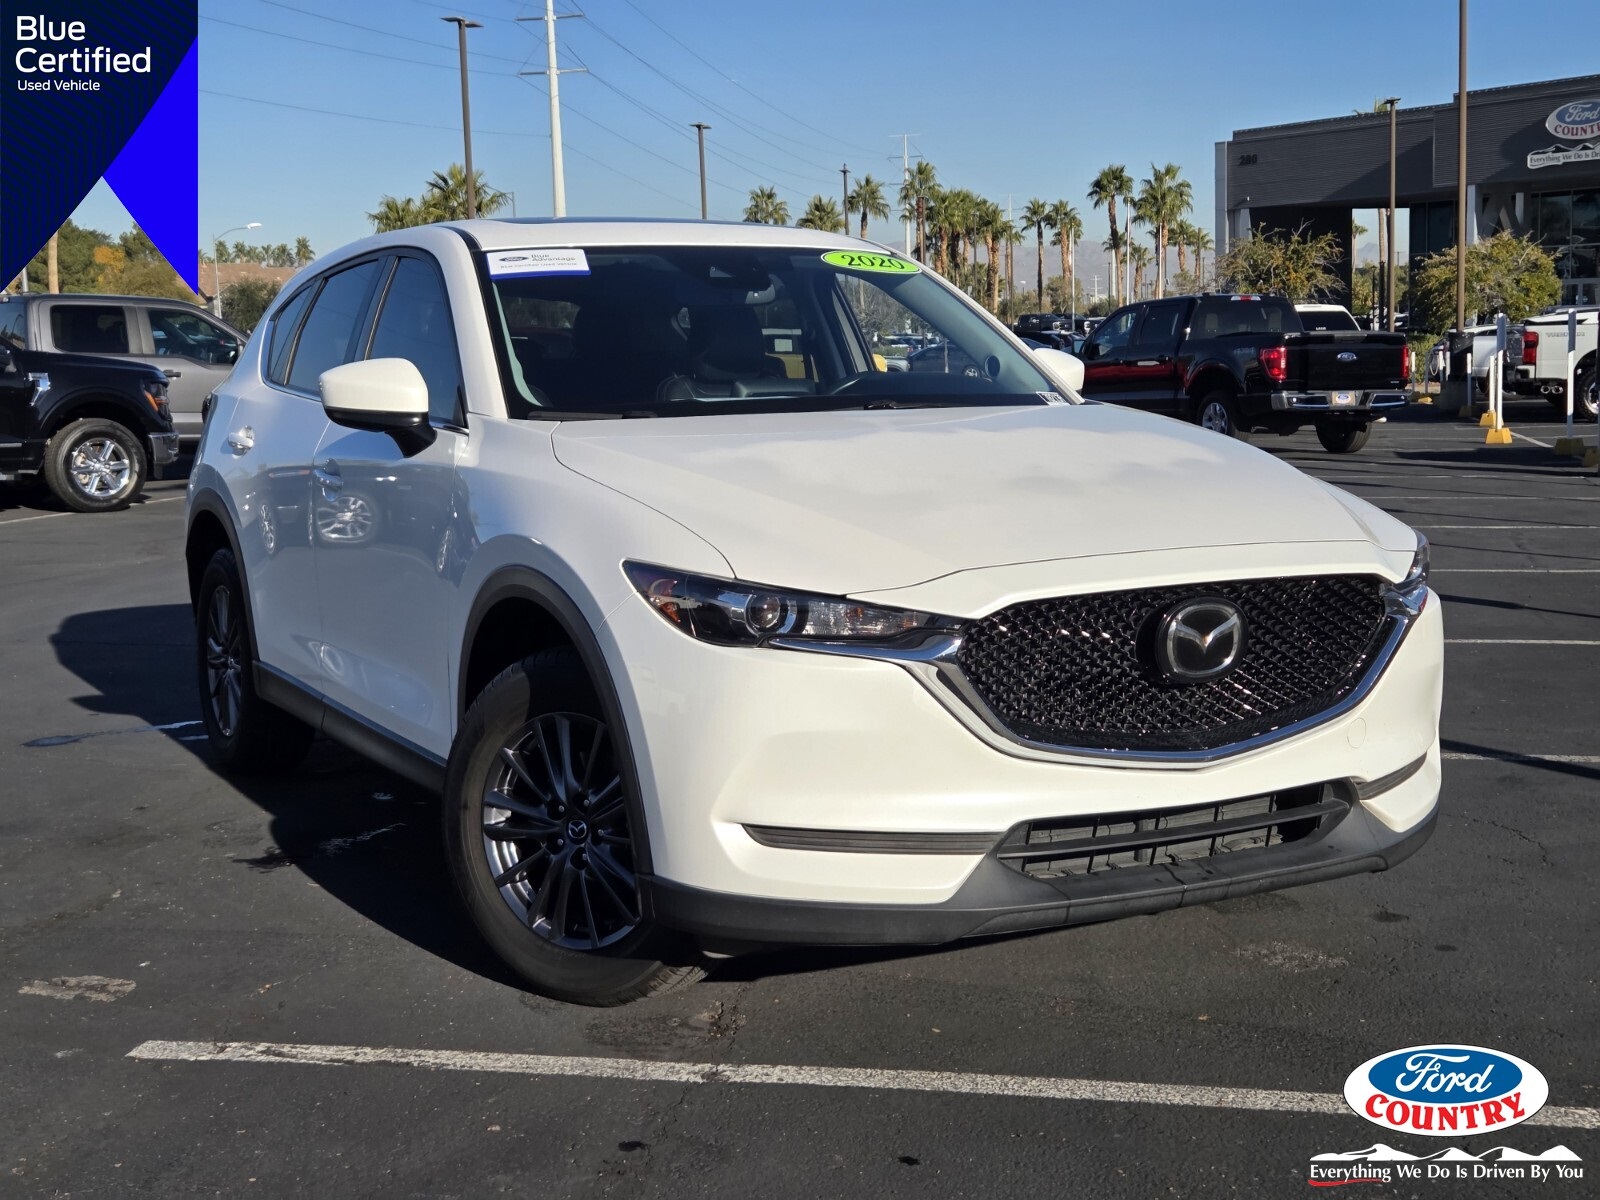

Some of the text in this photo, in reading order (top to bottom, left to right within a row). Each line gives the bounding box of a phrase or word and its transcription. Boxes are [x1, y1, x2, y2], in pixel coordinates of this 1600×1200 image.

[1564, 103, 1600, 122] Ford
[1530, 154, 1560, 164] Everything
[841, 254, 905, 270] 2020
